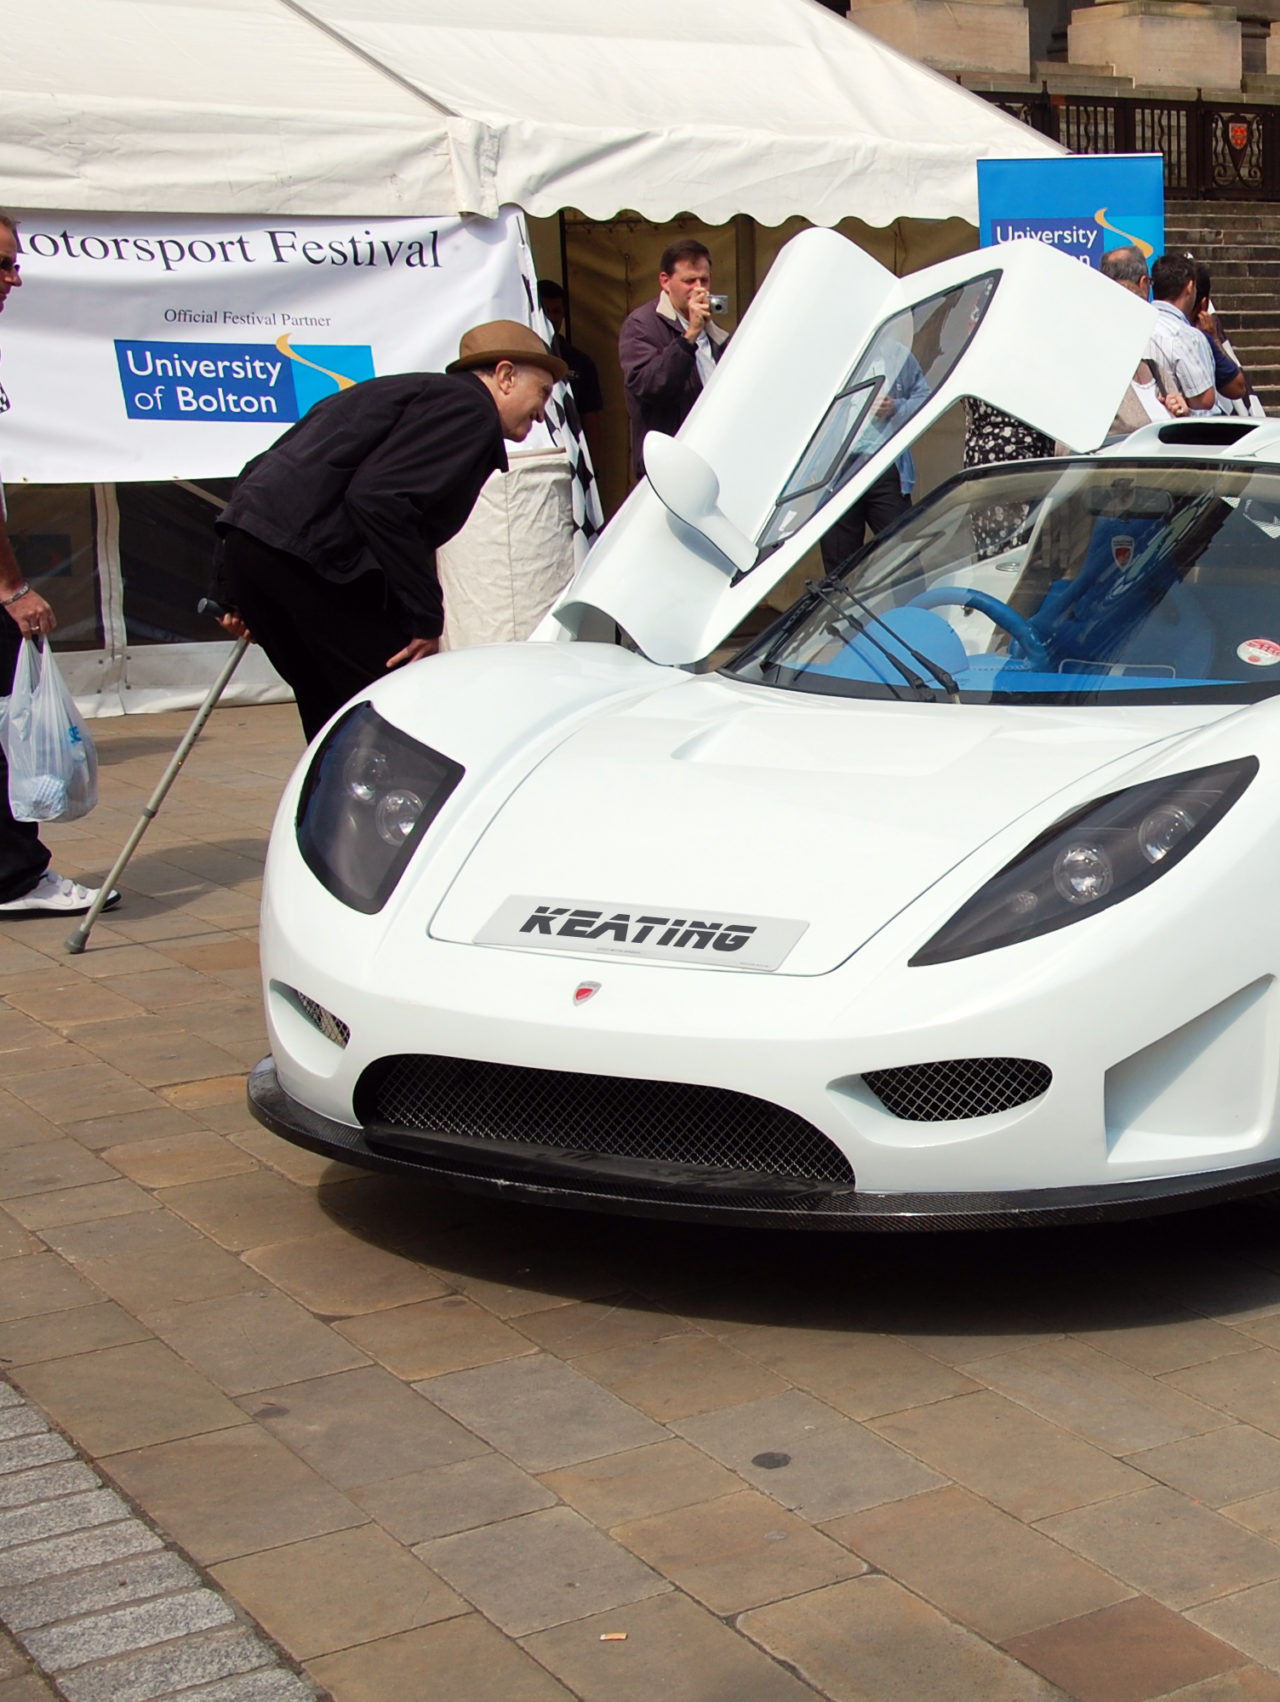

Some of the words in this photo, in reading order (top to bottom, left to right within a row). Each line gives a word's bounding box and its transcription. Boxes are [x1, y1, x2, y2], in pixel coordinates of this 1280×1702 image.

[264, 230, 442, 268] Festival
[996, 225, 1097, 249] University
[164, 308, 218, 324] Official
[223, 311, 276, 326] Festival
[281, 313, 332, 327] Partner
[126, 349, 282, 387] University
[134, 385, 165, 411] of
[176, 386, 278, 413] Bolton
[519, 905, 757, 951] KEATING
